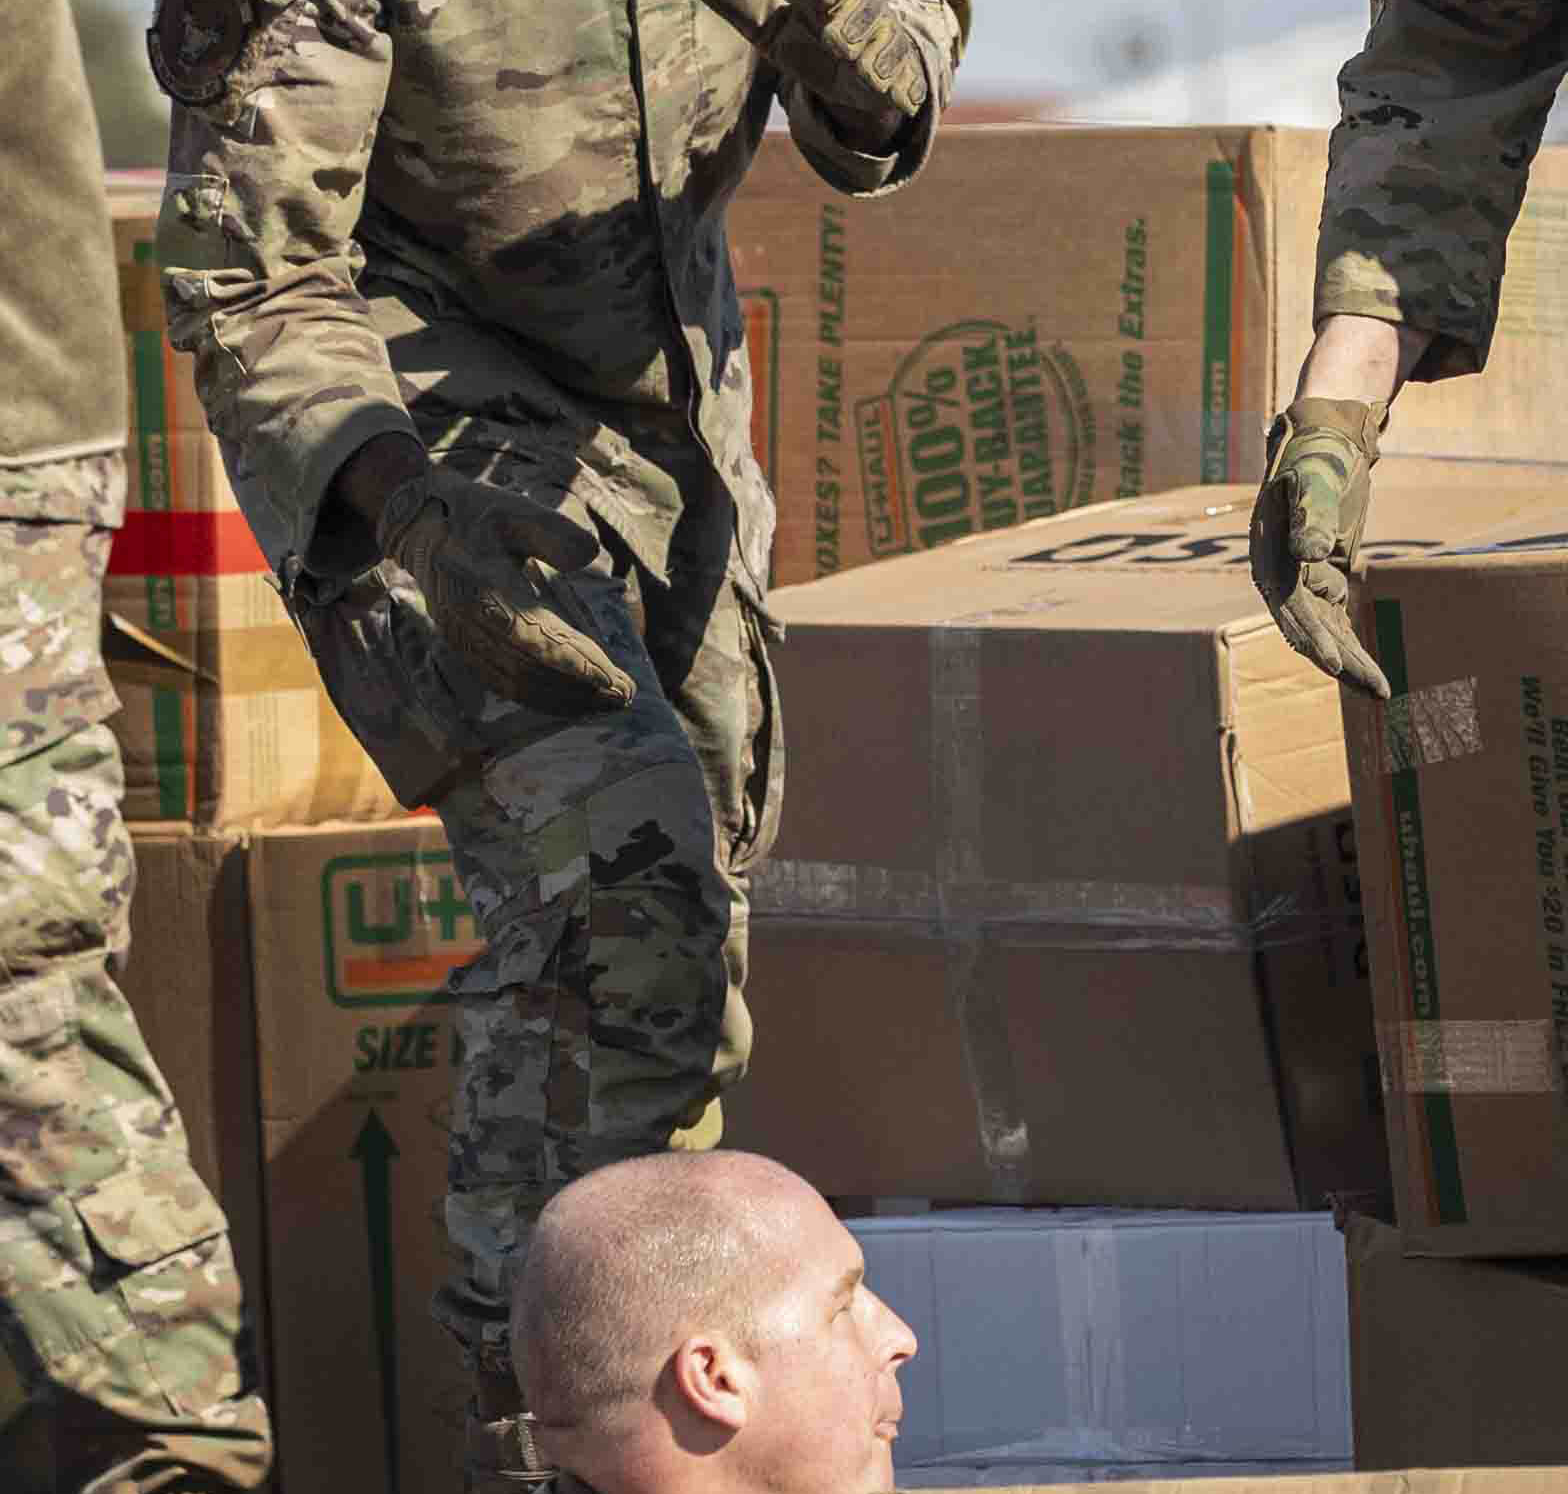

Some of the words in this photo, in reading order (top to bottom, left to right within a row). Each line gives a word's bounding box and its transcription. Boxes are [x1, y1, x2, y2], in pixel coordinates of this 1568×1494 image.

[817, 204, 846, 348] PLENTY!
[1119, 217, 1147, 340] Extras.
[815, 356, 844, 444] TAKE
[1004, 328, 1056, 519] UARANTEE
[1118, 352, 1145, 411] the
[902, 368, 973, 549] 100%
[961, 340, 1017, 533] UY-BACK
[815, 456, 844, 577] OXES?
[1528, 754, 1551, 817] Give
[1535, 828, 1561, 878] You
[1545, 943, 1567, 972] in
[353, 1026, 438, 1071] SIZE
